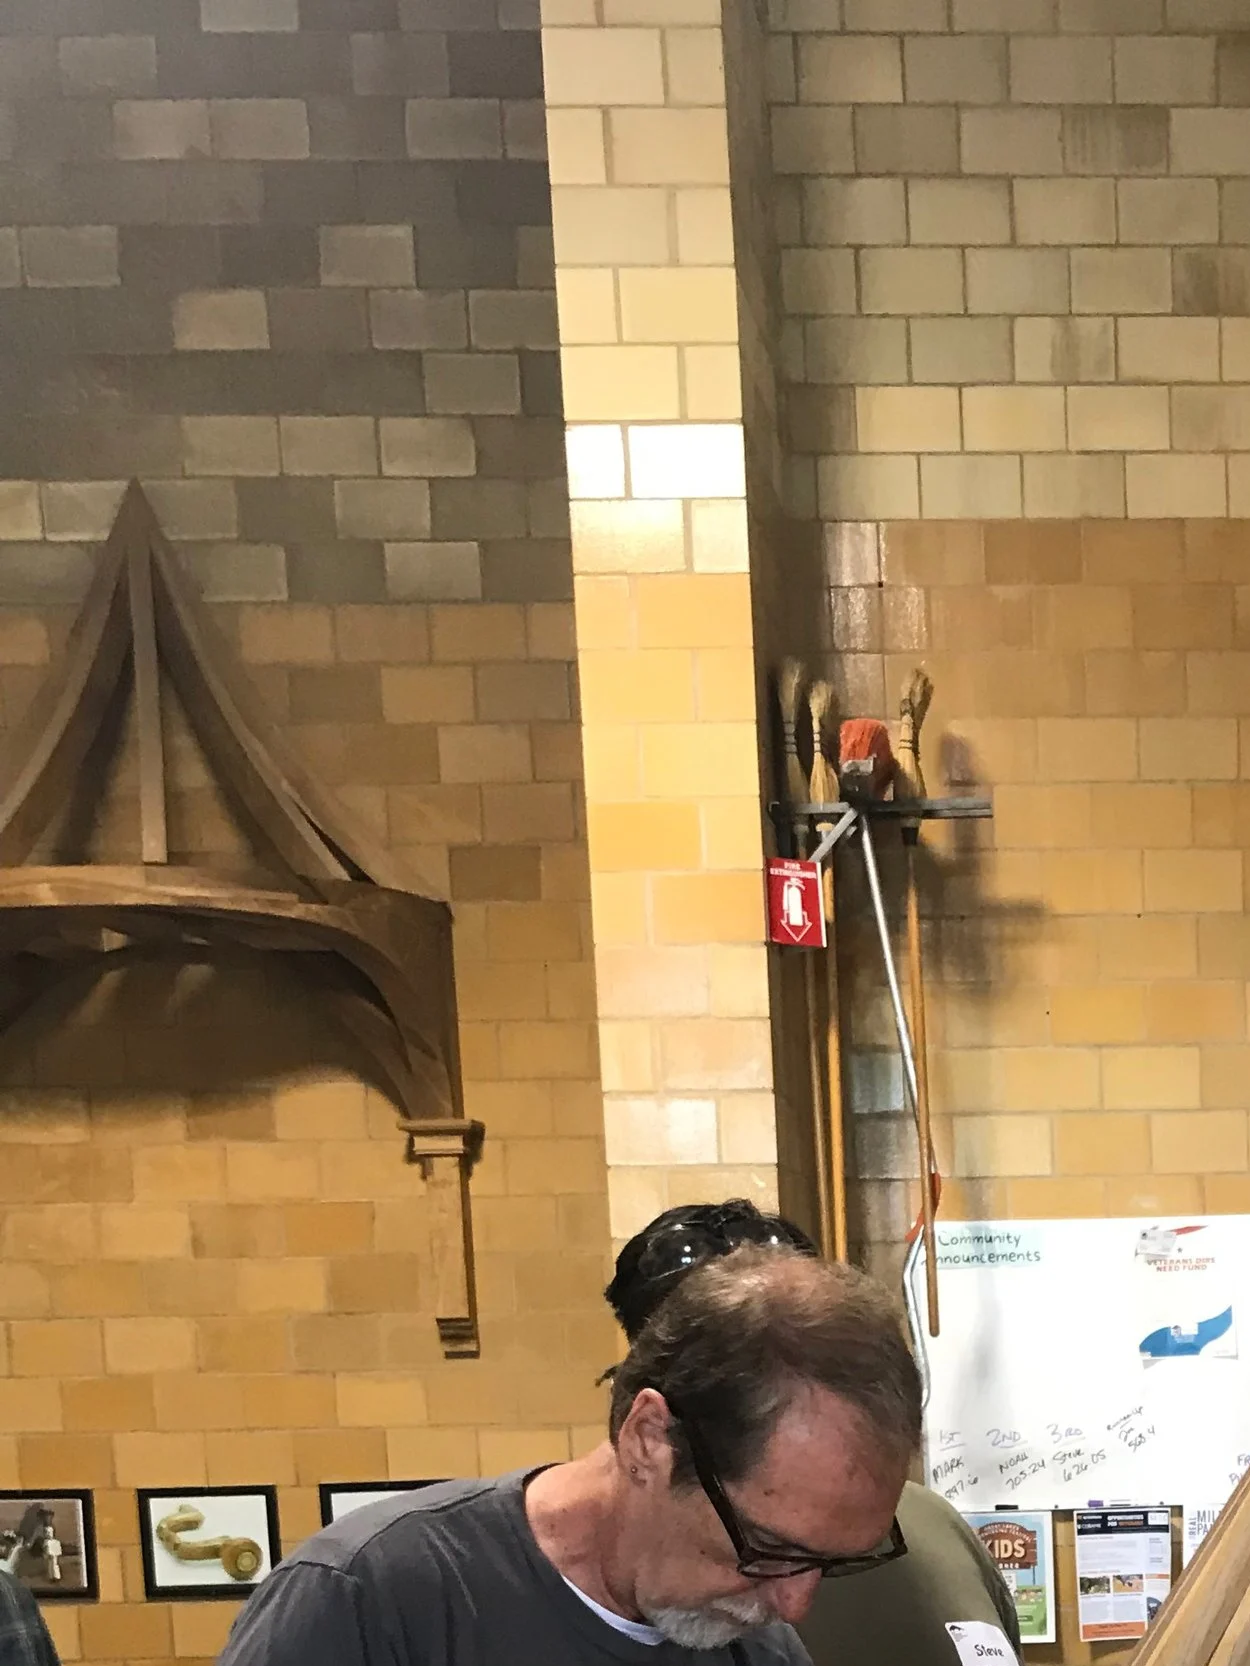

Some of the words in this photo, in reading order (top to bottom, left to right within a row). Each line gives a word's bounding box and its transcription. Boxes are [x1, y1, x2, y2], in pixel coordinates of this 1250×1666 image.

[937, 1231, 1021, 1248] Community
[921, 1250, 1041, 1265] nnouncements
[974, 1644, 1005, 1657] Steve
